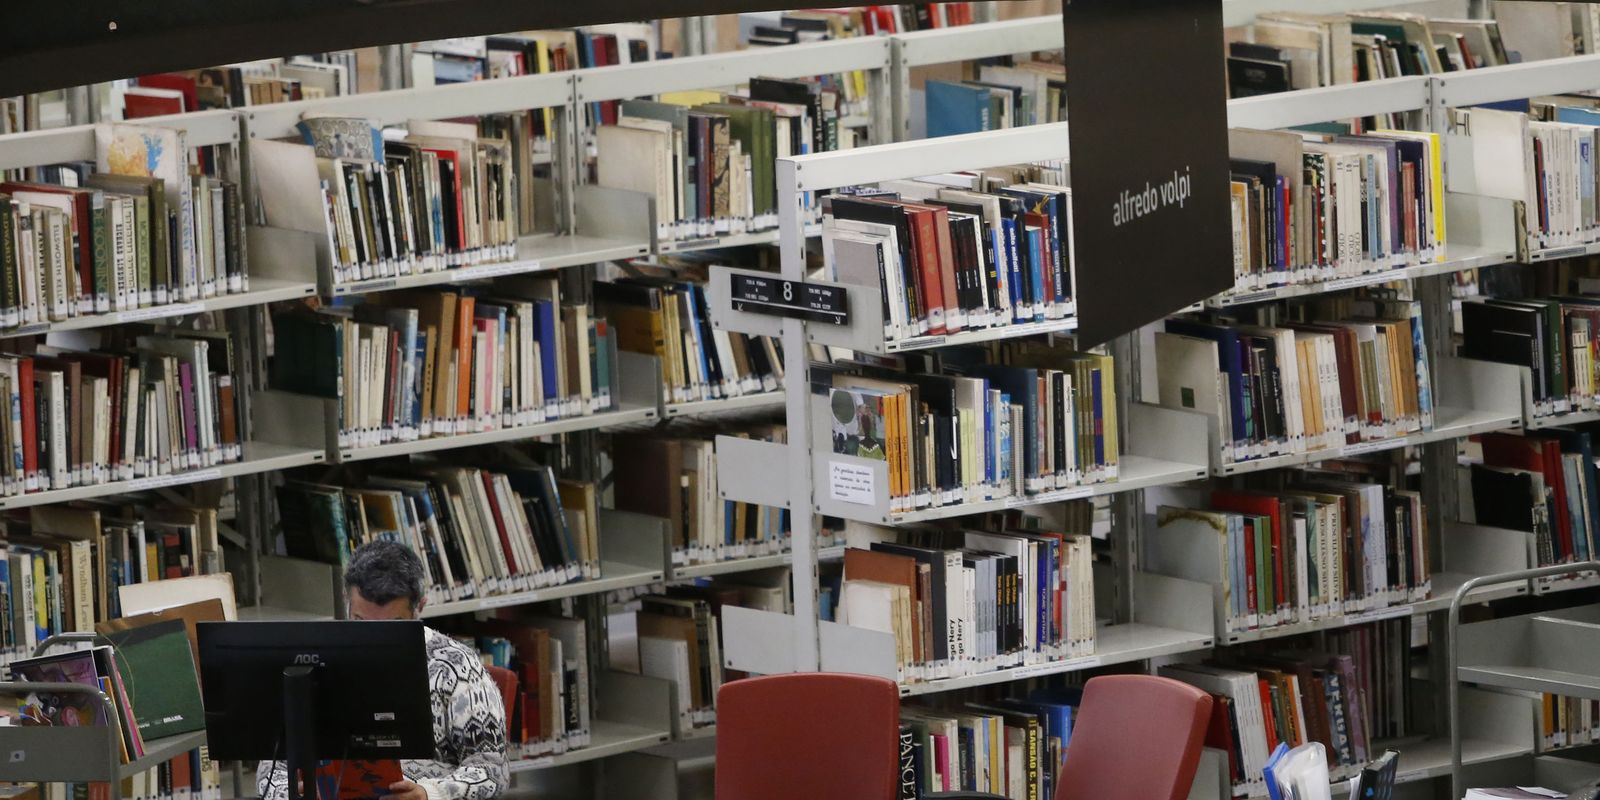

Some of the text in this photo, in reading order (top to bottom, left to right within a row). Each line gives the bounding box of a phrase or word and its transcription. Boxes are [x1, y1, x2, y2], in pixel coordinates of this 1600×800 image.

[1113, 166, 1191, 226] alfredo volpi
[53, 224, 62, 276] ELLSWORTH
[116, 224, 125, 292] RICHARD LINDNER
[5, 266, 14, 306] HOPPE
[783, 281, 792, 301] 8
[78, 552, 89, 602] Wyndham
[294, 654, 320, 664] AOC
